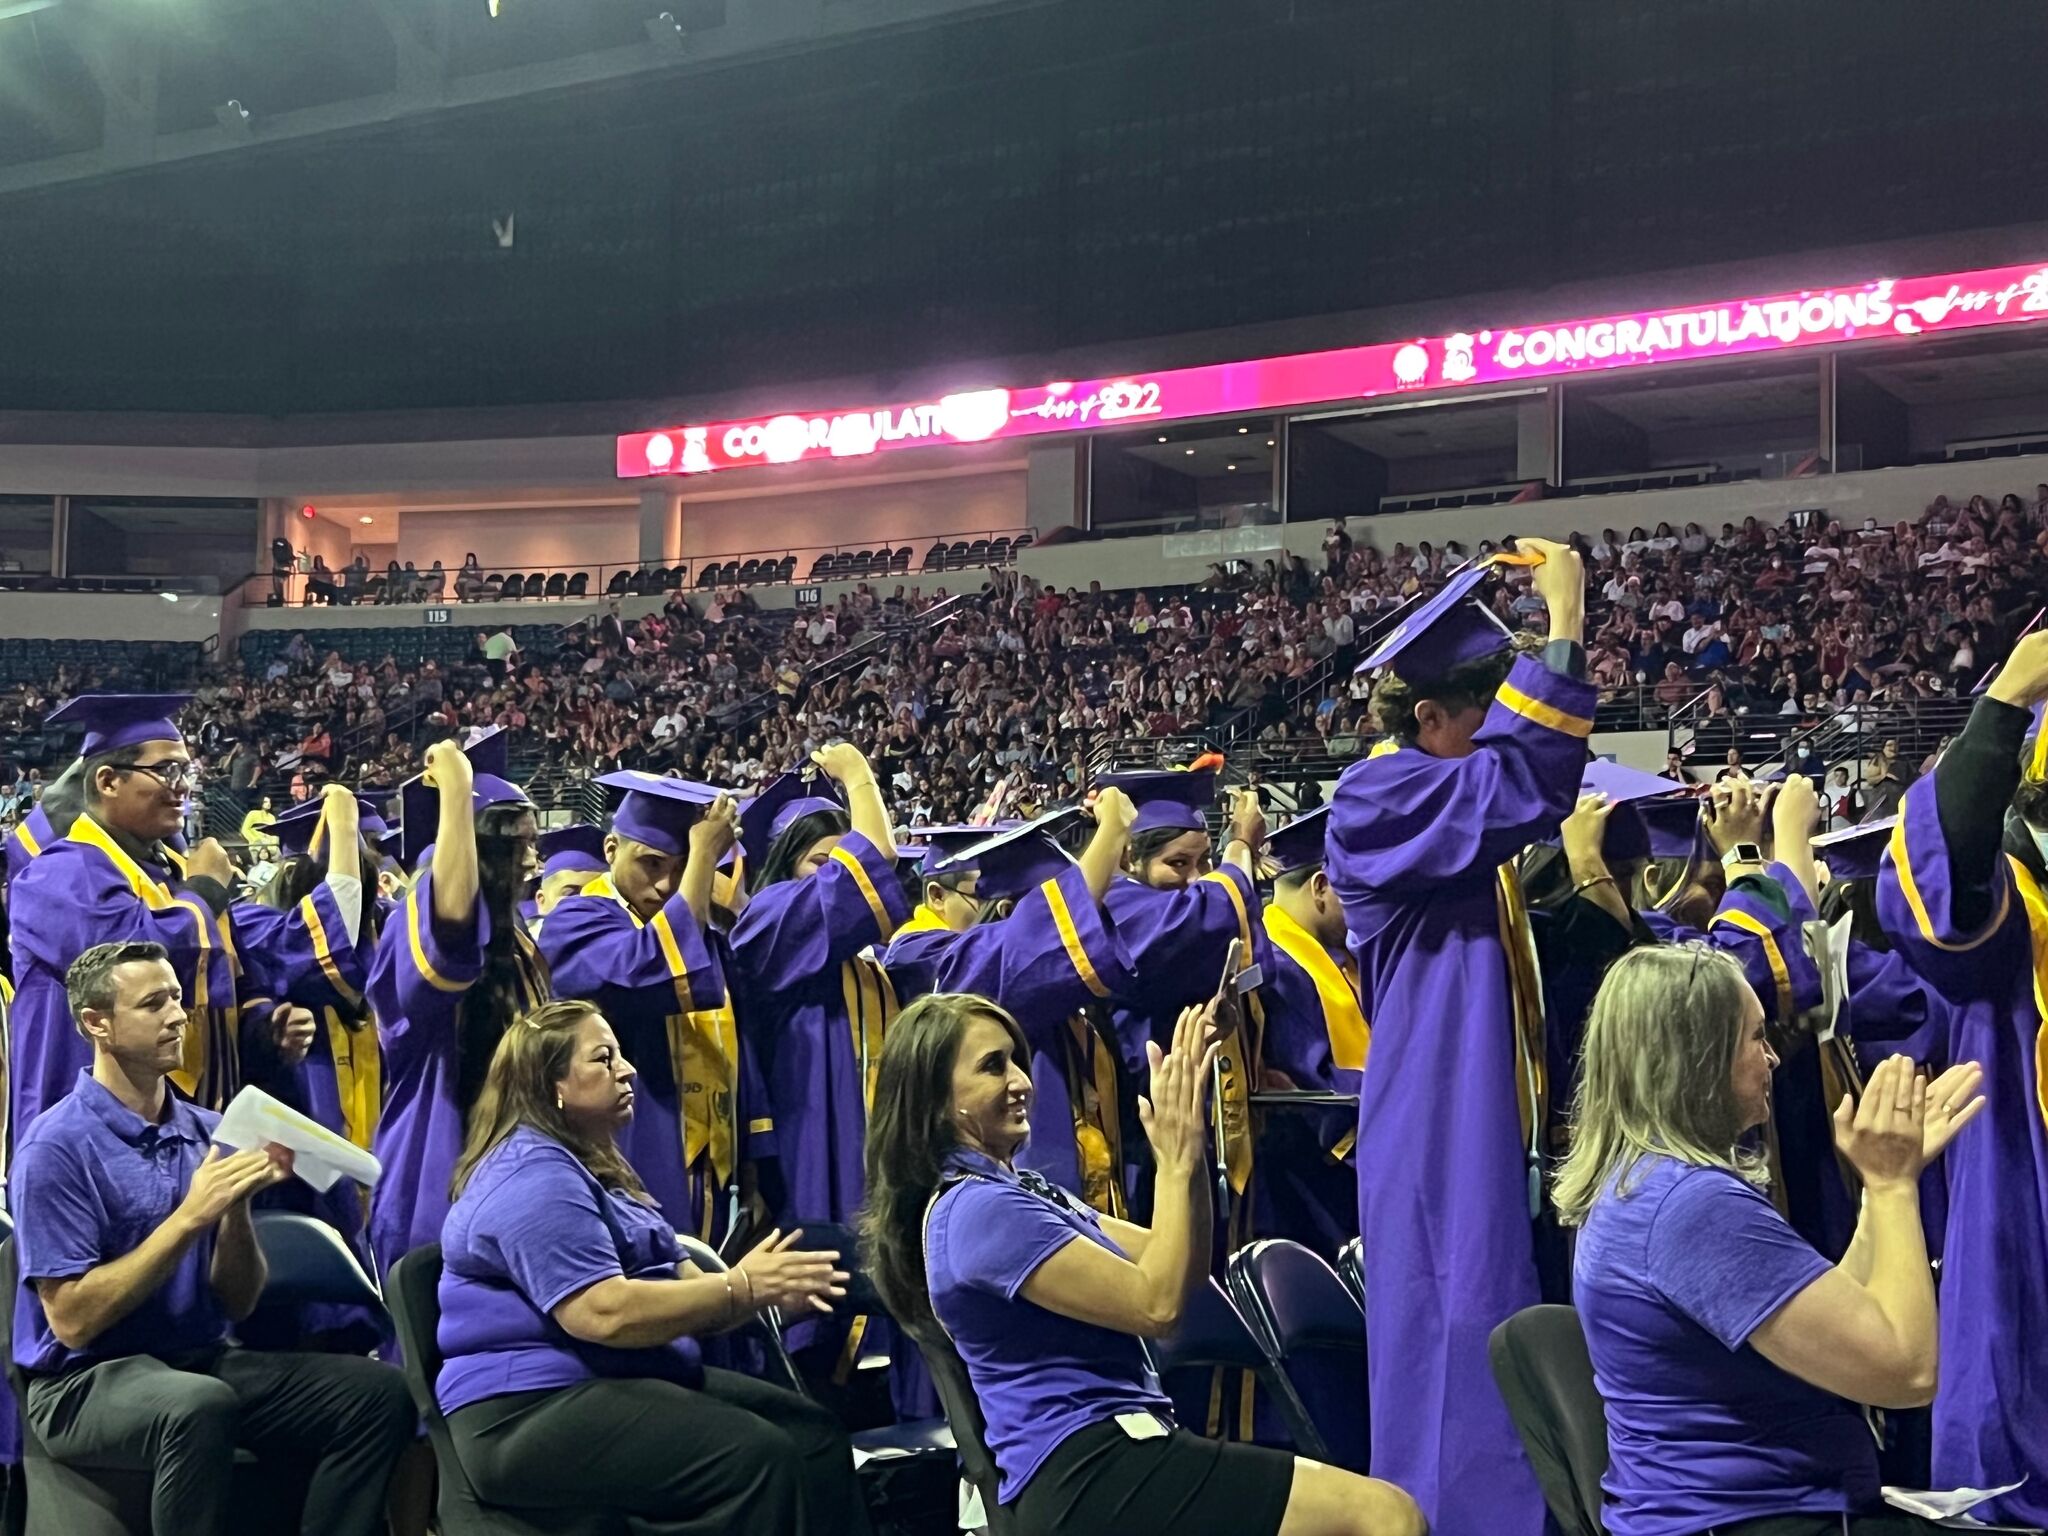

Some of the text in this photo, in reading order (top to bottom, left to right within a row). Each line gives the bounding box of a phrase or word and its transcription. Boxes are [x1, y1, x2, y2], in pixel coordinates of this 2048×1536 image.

[1497, 292, 1893, 369] CONGRATULATIONS
[799, 589, 818, 602] 116
[428, 610, 448, 623] 115
